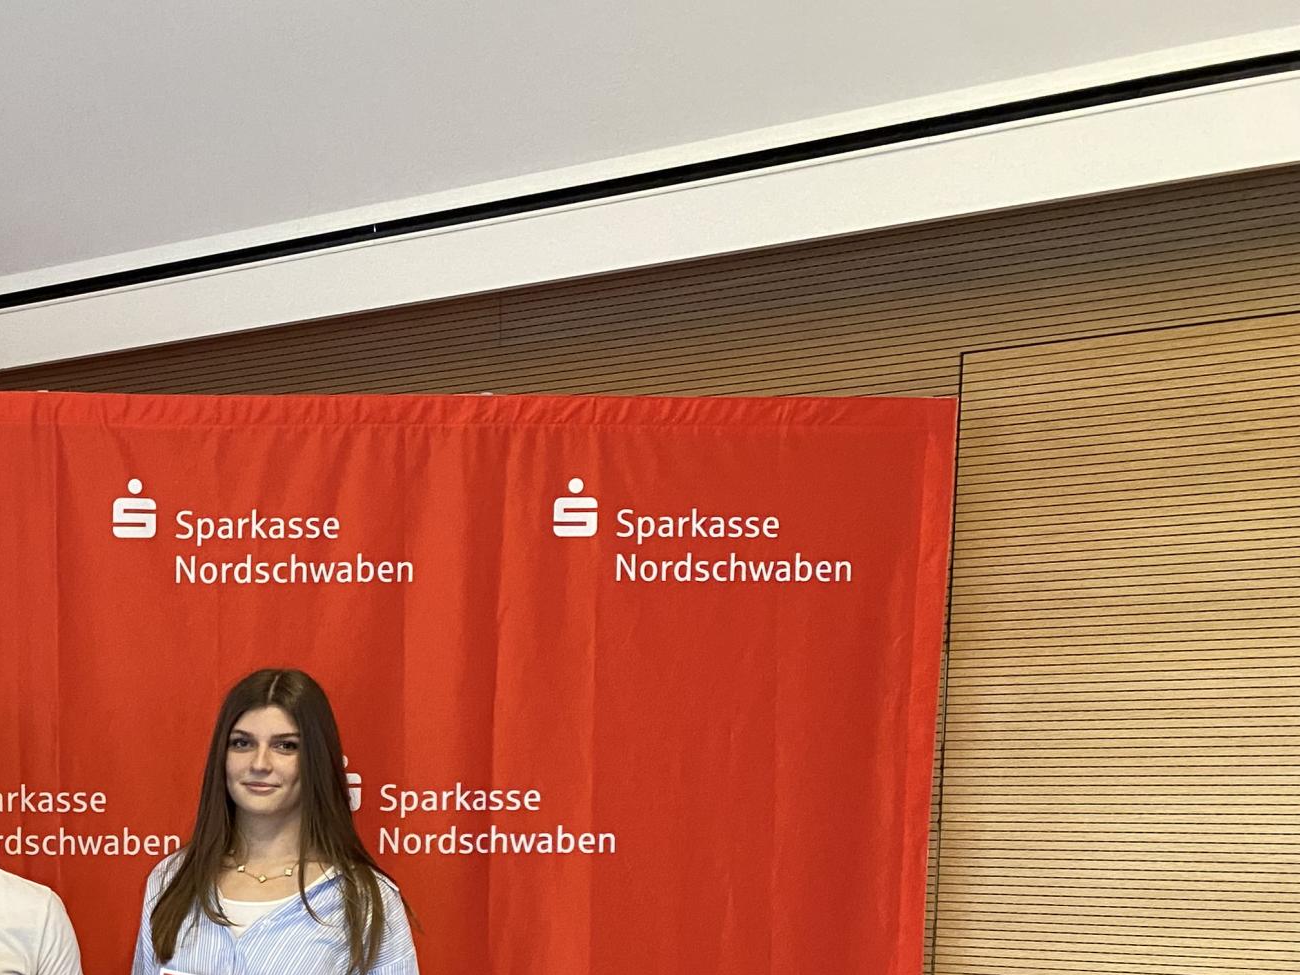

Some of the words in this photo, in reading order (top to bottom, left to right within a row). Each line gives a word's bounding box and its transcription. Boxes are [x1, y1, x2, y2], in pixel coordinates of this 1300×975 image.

[175, 508, 340, 547] Sparkasse
[616, 508, 780, 545] Sparkasse
[175, 552, 414, 584] Nordschwaben
[615, 552, 852, 582] Nordschwaben
[379, 782, 541, 819] Sparkasse
[379, 824, 616, 855] Nordschwaben
